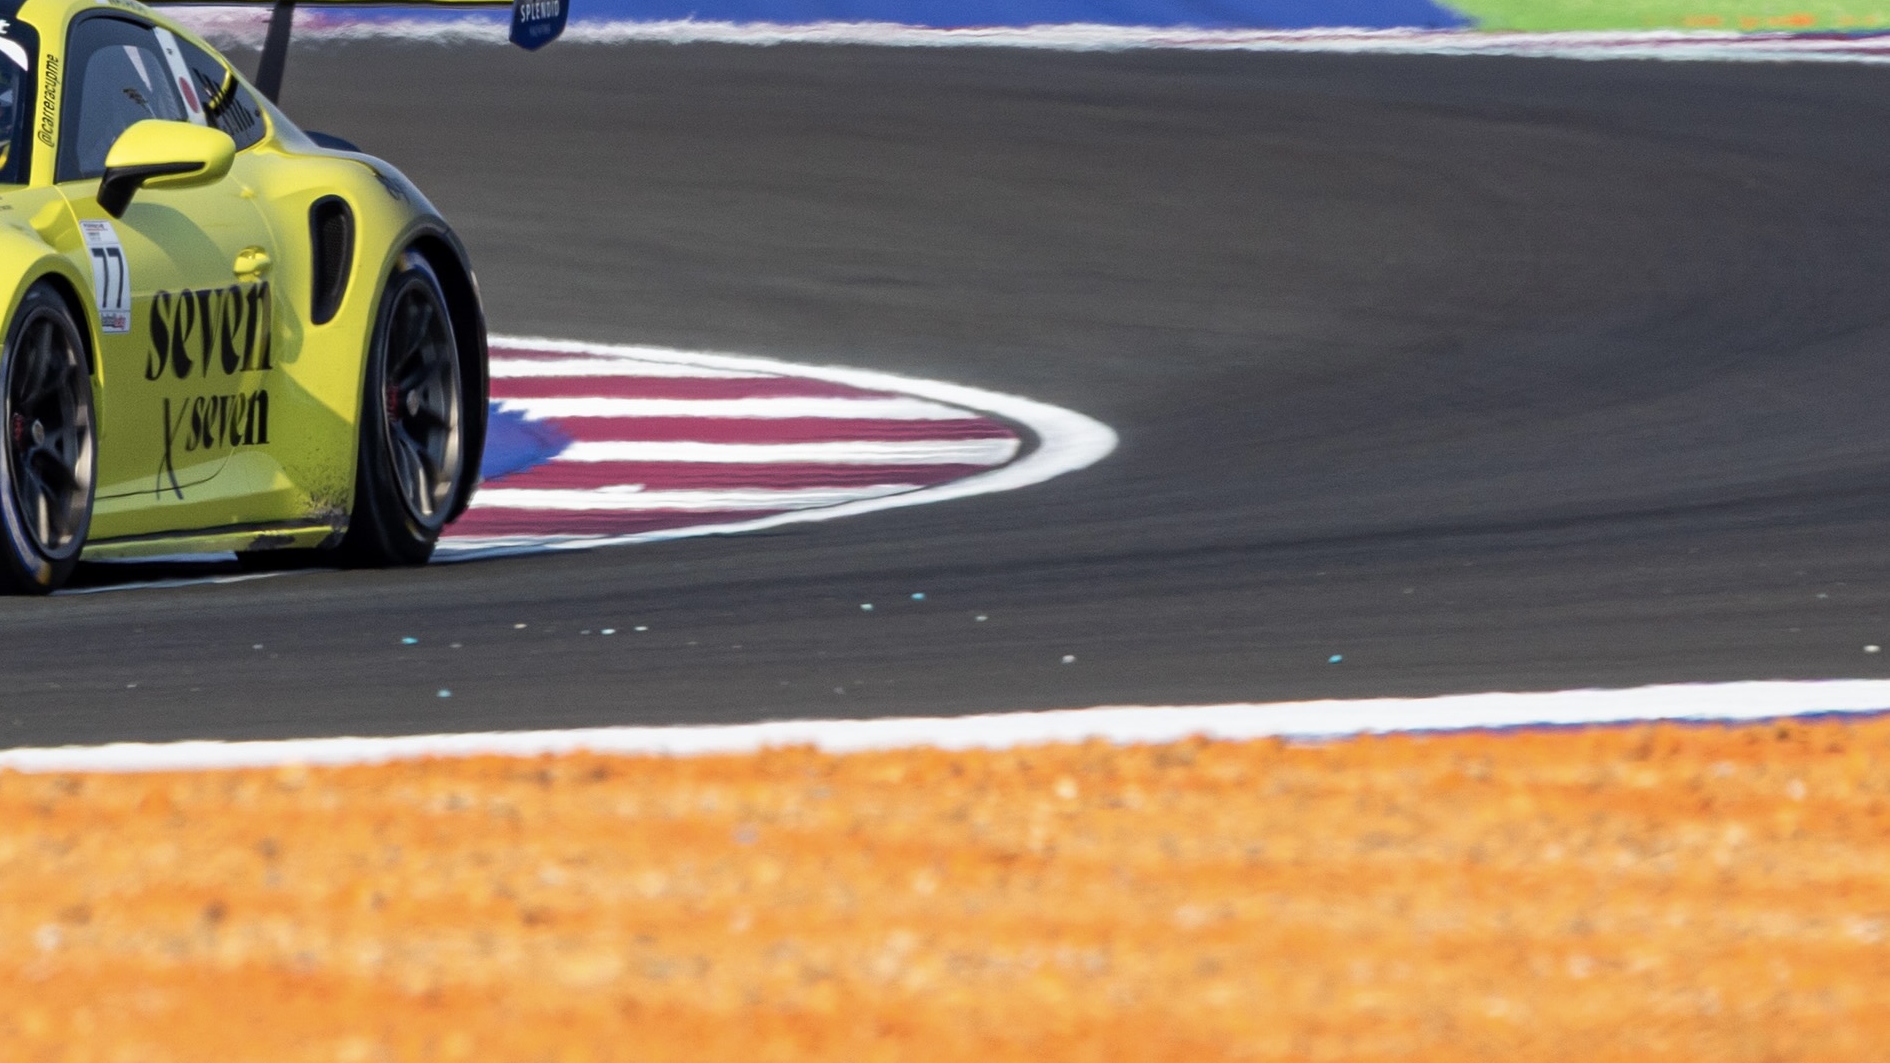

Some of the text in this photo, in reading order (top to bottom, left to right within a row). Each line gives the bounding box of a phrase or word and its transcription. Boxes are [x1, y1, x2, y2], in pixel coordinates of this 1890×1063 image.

[520, 0, 560, 23] SPLENDID
[91, 247, 124, 309] 77
[145, 280, 274, 381] seven
[185, 388, 270, 452] seven
